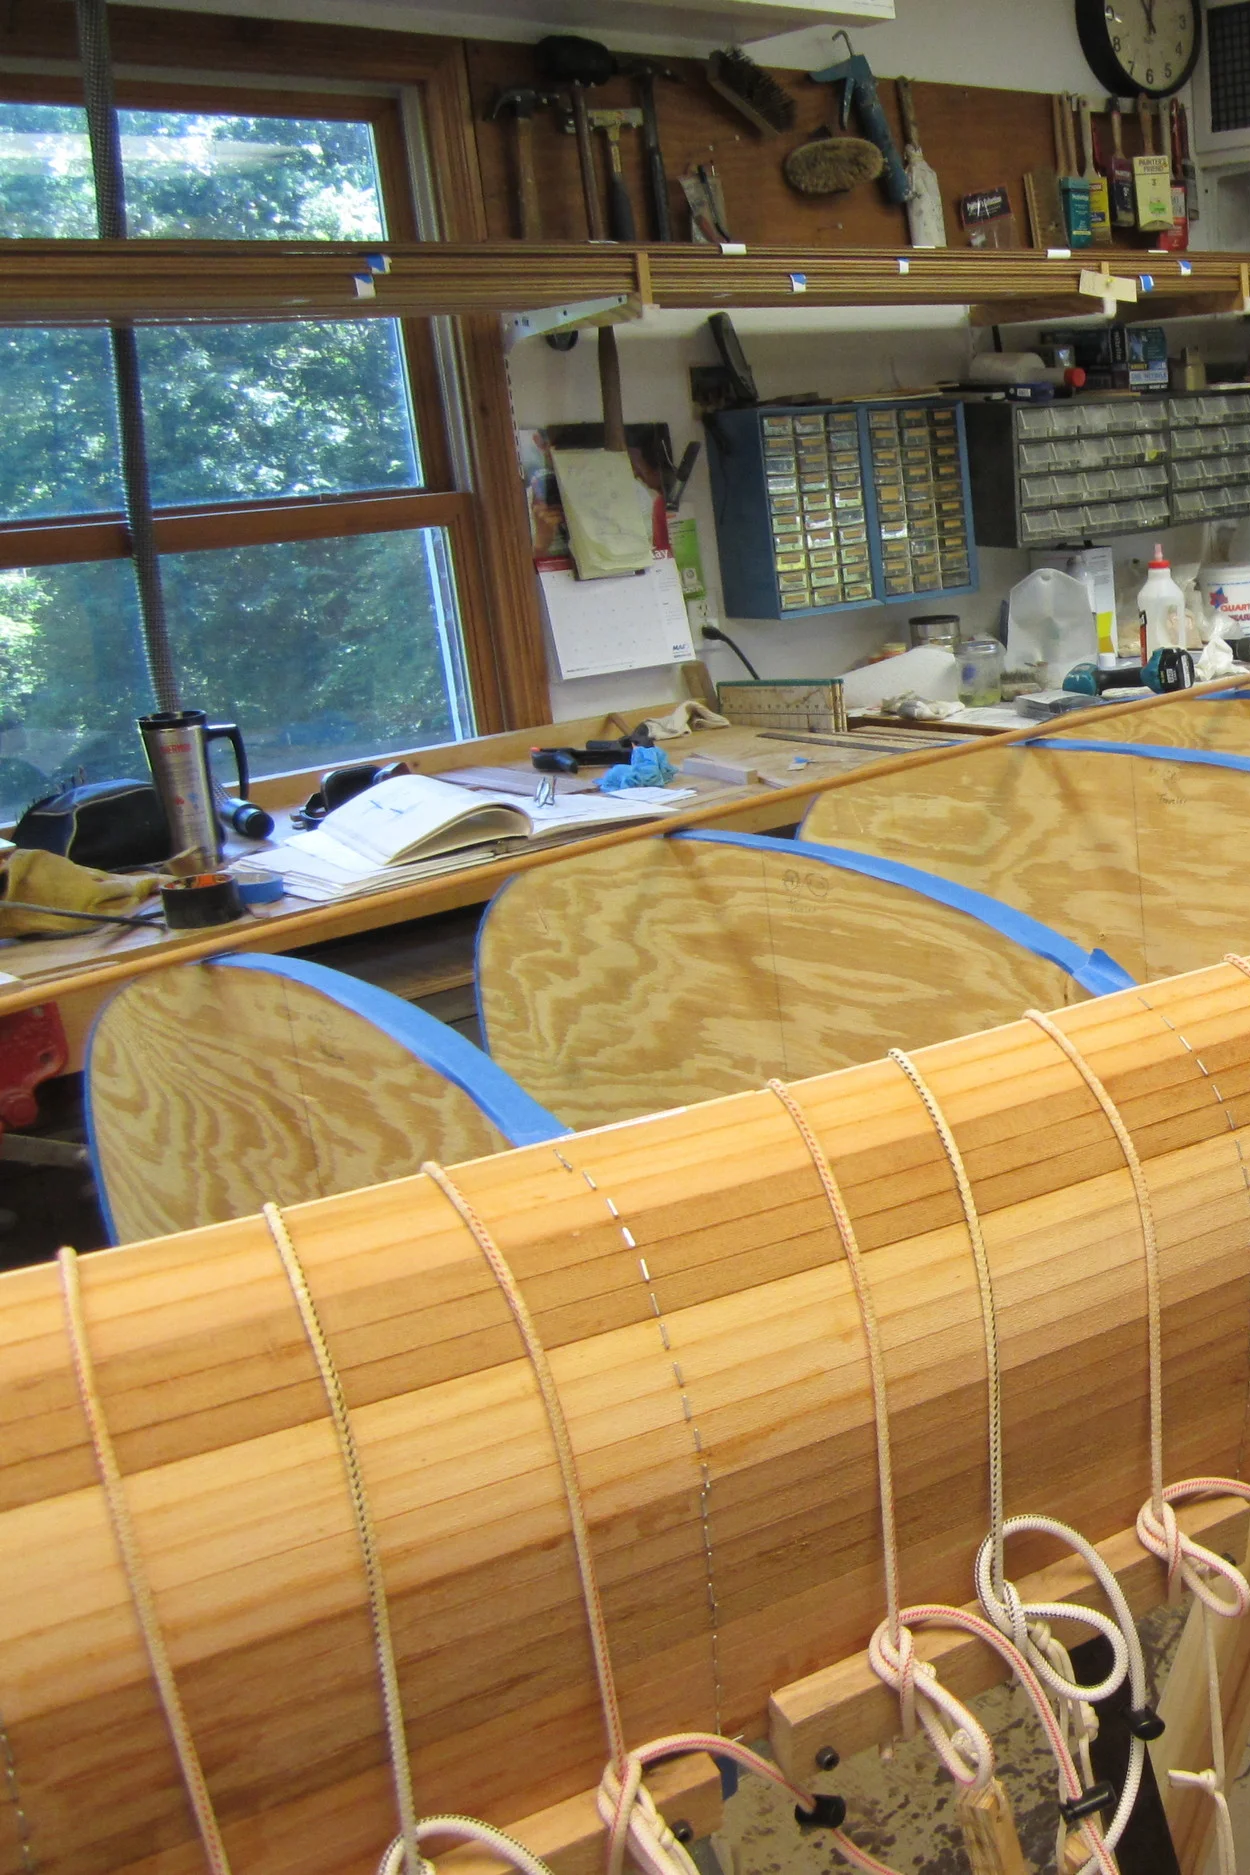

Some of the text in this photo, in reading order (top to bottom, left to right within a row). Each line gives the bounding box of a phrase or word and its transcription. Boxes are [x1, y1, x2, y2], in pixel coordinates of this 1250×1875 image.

[1179, 14, 1187, 31] 3
[1112, 36, 1121, 53] 8
[1175, 41, 1183, 57] 4
[1127, 60, 1135, 76] 7
[1145, 68, 1154, 85] 6
[1164, 62, 1172, 79] 5
